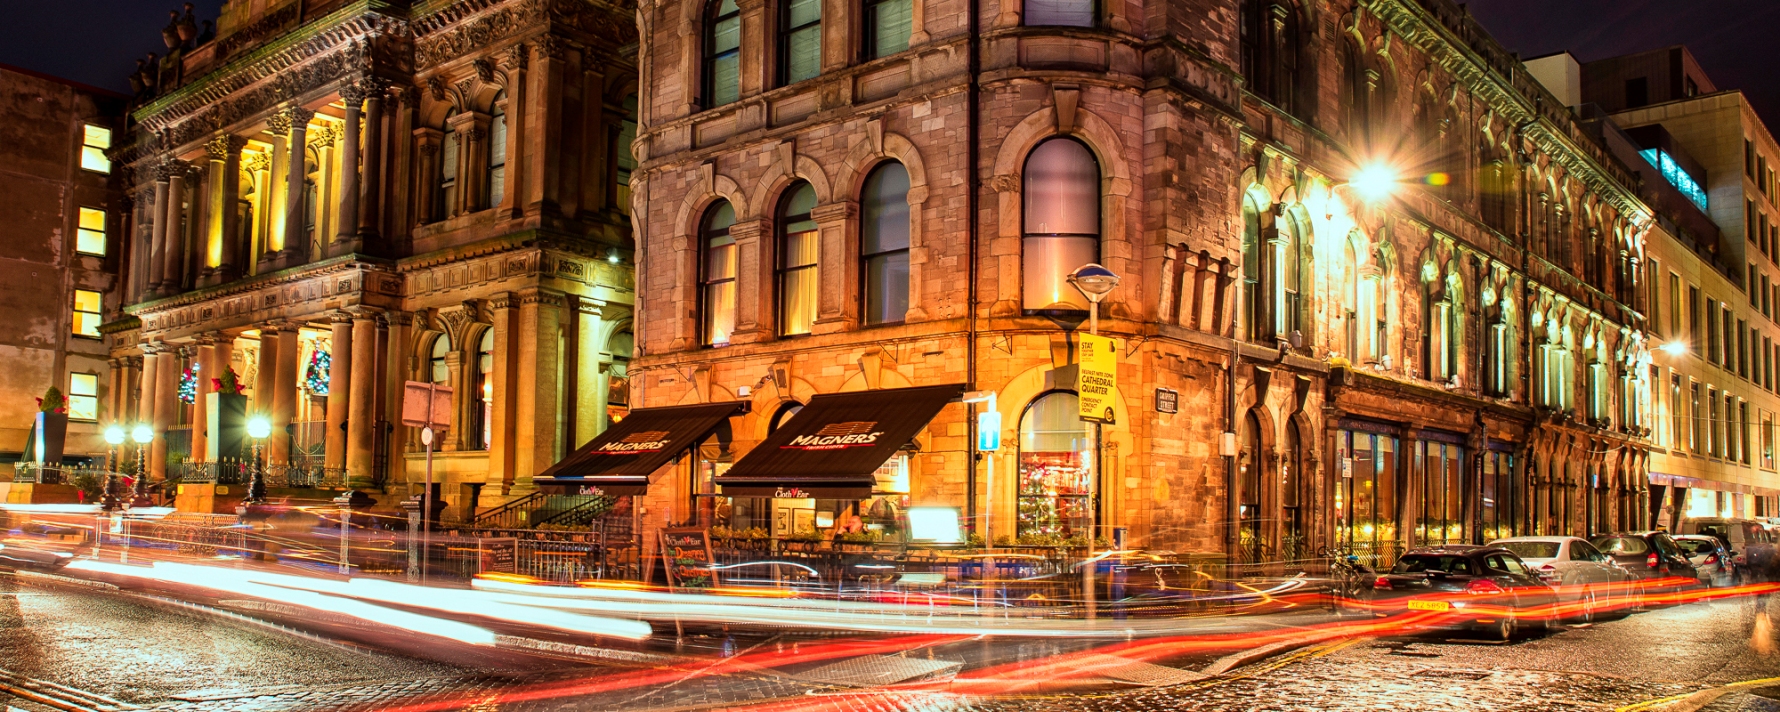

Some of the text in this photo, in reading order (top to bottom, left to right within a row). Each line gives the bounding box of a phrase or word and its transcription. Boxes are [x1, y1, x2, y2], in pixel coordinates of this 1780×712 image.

[1082, 375, 1113, 387] CATHEDRAL
[1082, 384, 1108, 395] QUARTER
[1081, 396, 1102, 404] EMERGENCY
[1160, 400, 1174, 409] STREET
[789, 432, 882, 446] MAGNERS
[599, 441, 669, 452] MAGNERS
[775, 490, 810, 498] Cloth Ear
[670, 538, 701, 546] Cloth Ear
